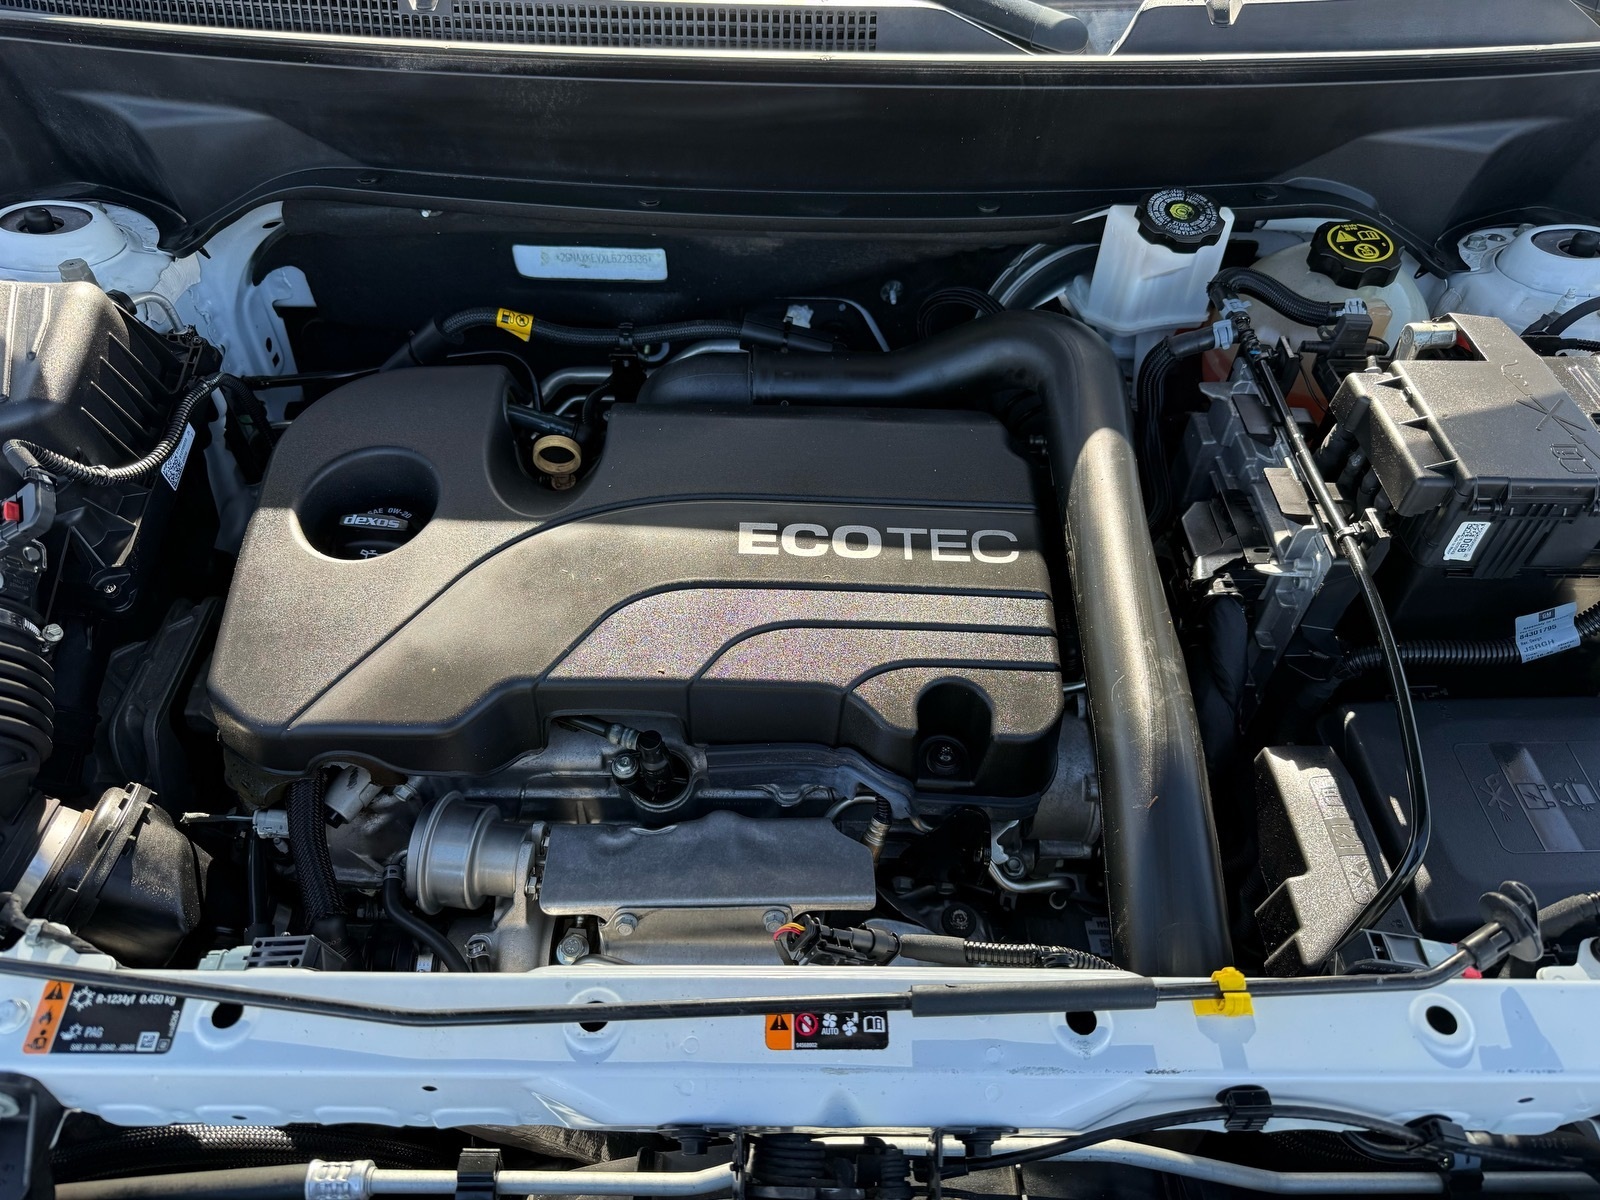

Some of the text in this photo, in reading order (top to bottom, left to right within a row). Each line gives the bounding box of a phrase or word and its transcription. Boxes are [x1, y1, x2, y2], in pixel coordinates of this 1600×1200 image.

[343, 514, 400, 529] dexos
[738, 521, 1020, 564] ECOTEC
[1457, 538, 1473, 553] DGB
[95, 993, 177, 1007] R-1234yf 0.450 kg
[84, 1025, 105, 1039] PAG
[821, 1027, 840, 1036] AUTO
